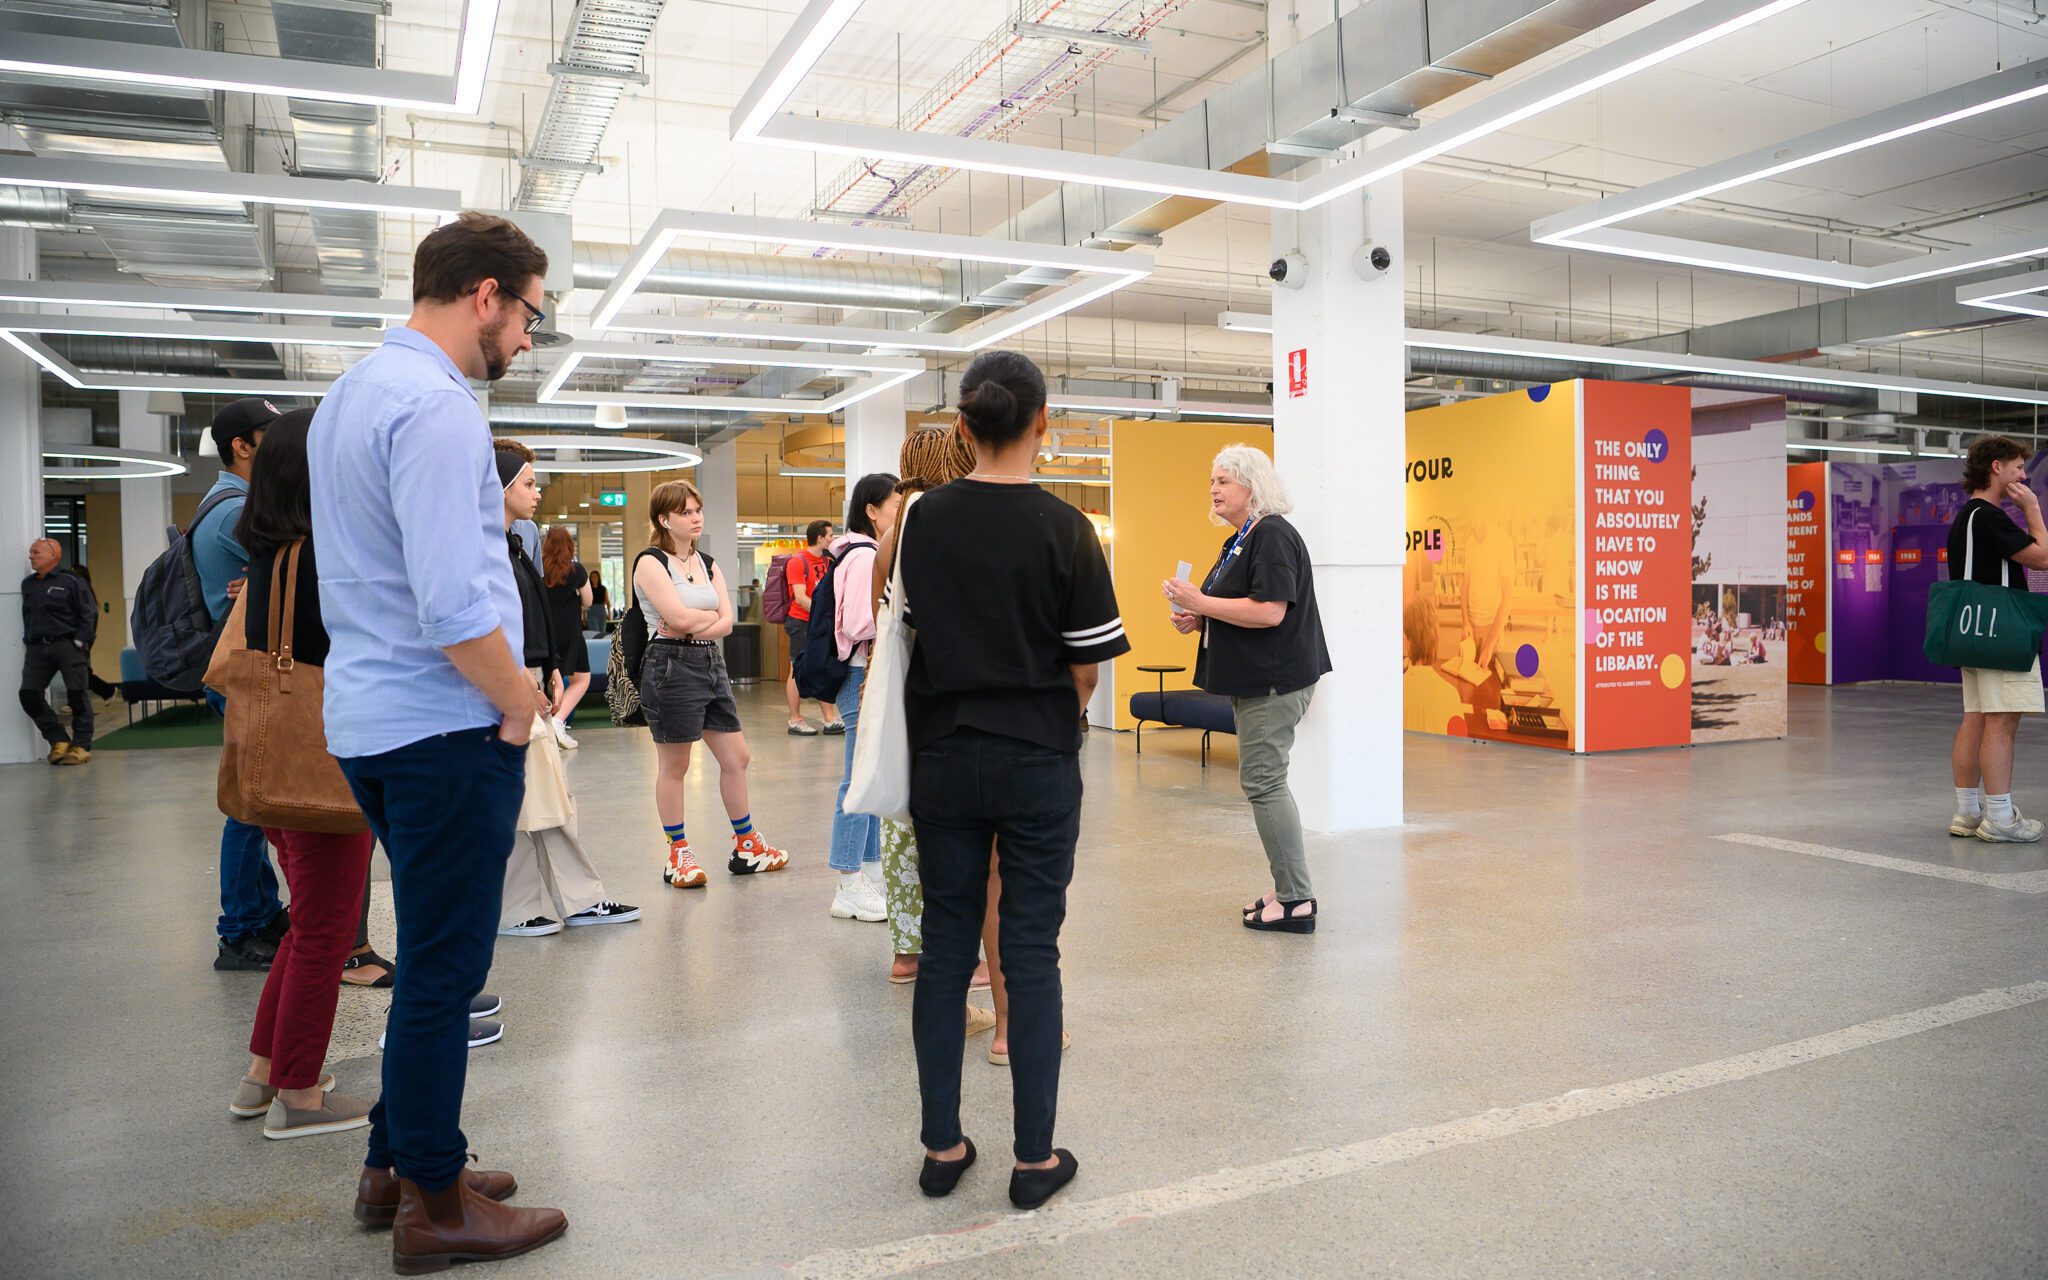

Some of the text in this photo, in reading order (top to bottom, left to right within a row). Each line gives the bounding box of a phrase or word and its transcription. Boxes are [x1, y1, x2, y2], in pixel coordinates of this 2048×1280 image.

[1595, 440, 1663, 458] THE ONLY
[1595, 464, 1640, 481] THING
[1595, 488, 1665, 506] THAT YOU
[1595, 512, 1681, 529] ABSOLUTELY
[1596, 536, 1657, 553] HAVE TO
[1596, 560, 1643, 576] KNOW
[1596, 584, 1638, 600] IS THE
[1801, 579, 1815, 590] OF
[1596, 607, 1667, 624] LOCATION
[1799, 607, 1806, 617] A
[1595, 631, 1644, 648] OF THE
[1595, 654, 1659, 673] LIBRARY.
